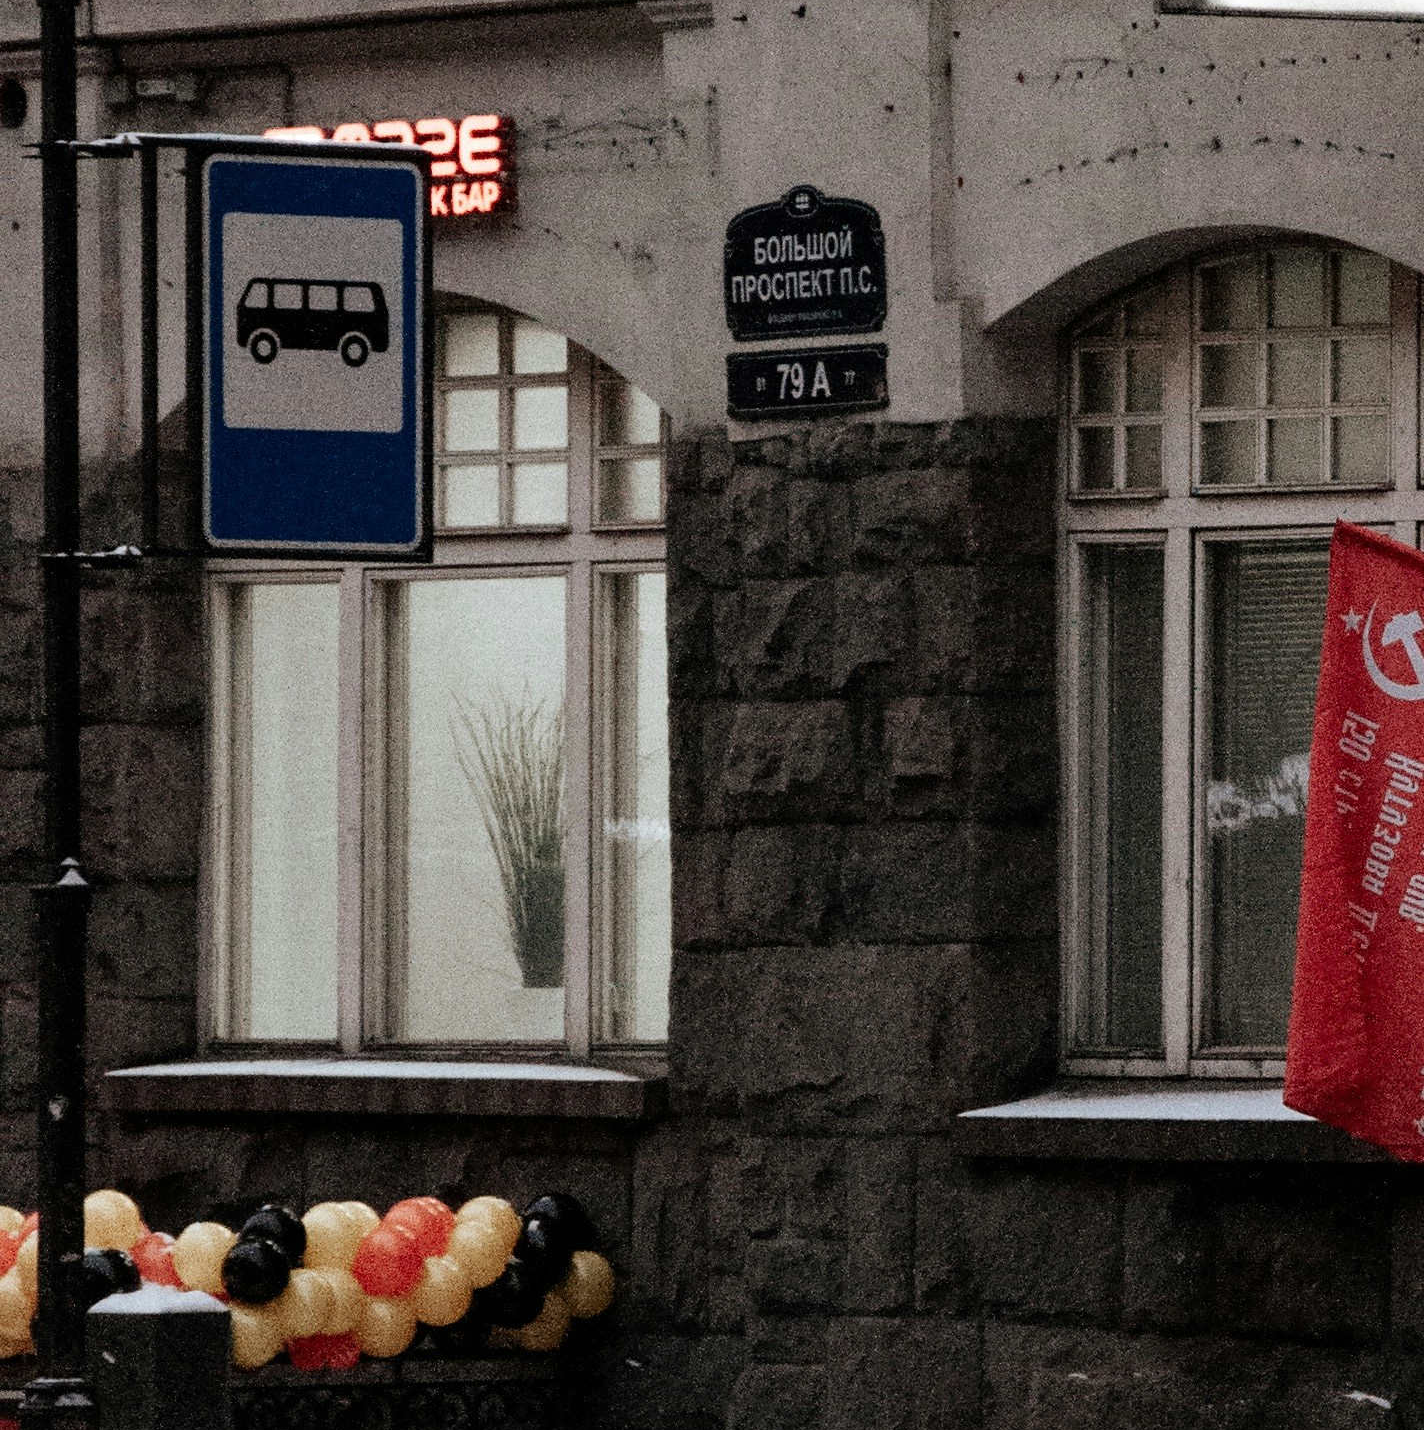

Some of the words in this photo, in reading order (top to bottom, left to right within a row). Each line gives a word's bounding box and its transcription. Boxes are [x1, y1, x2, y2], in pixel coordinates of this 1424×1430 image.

[451, 181, 499, 215] БАР
[754, 224, 852, 265] БОЛЬШОЙ
[732, 268, 834, 303] ПРОСПЕКТ
[839, 265, 878, 295] П.С.
